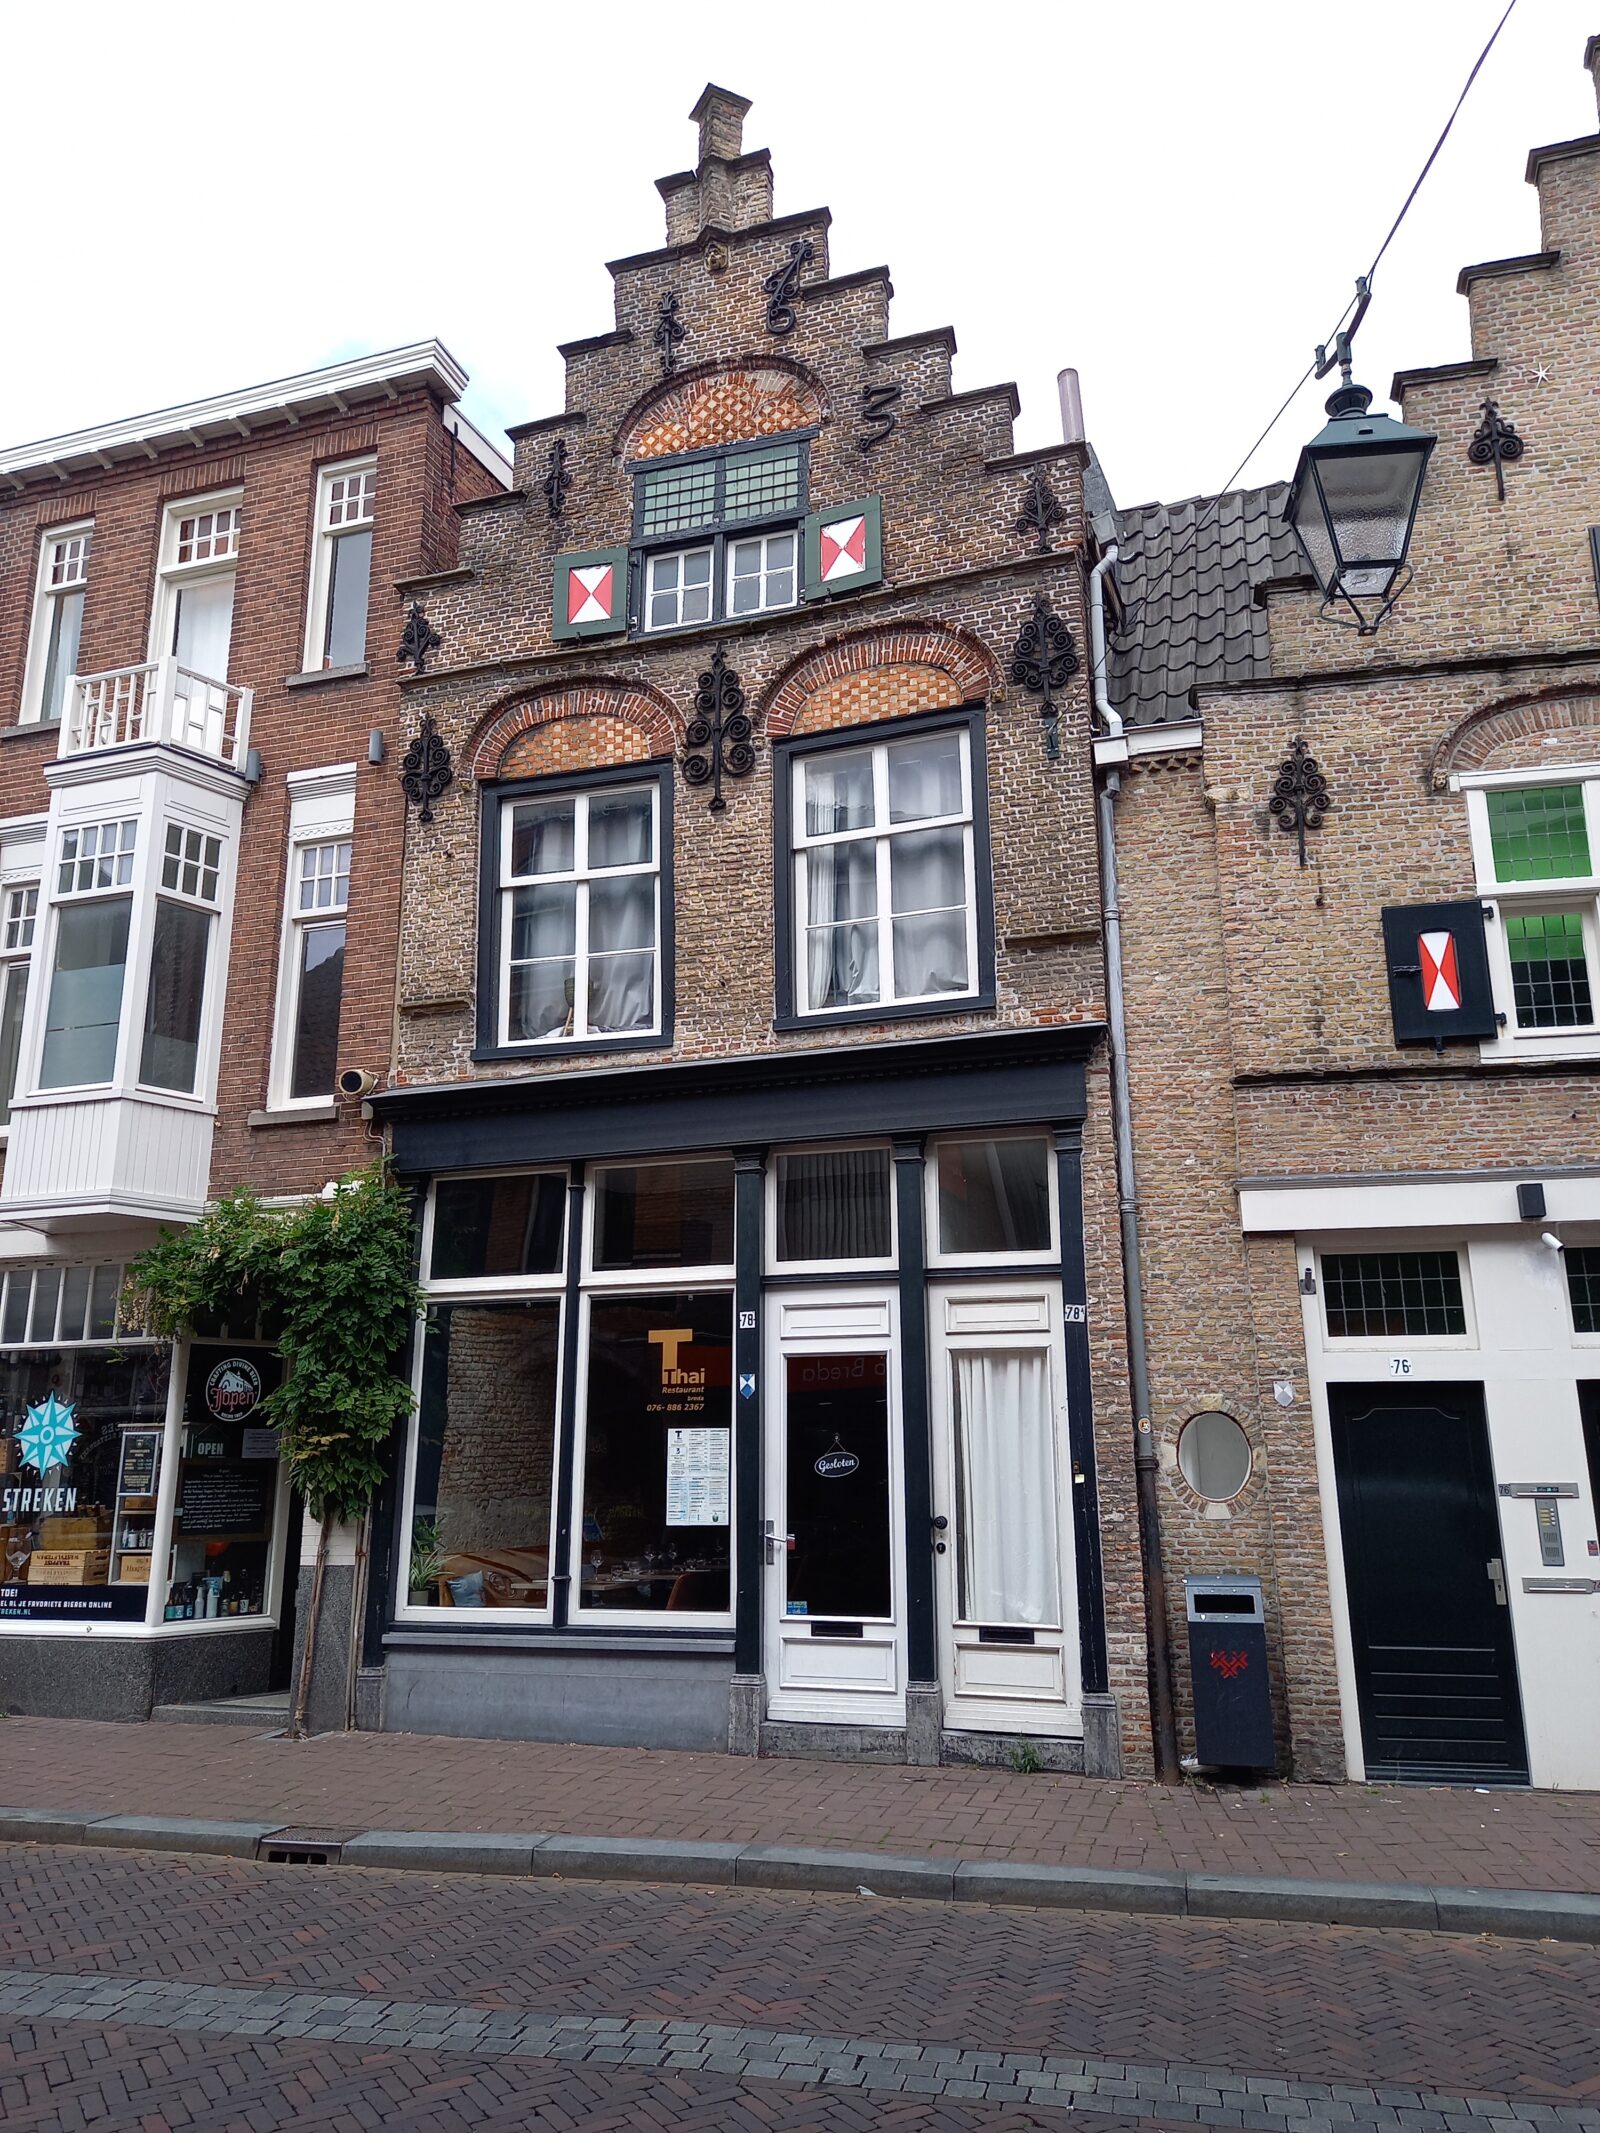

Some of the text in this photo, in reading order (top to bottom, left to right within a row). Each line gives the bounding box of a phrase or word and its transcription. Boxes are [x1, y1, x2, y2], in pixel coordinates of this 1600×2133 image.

[741, 1313, 754, 1327] 78
[232, 1361, 252, 1373] DIVINE
[249, 1370, 259, 1386] BEER
[1393, 1359, 1410, 1374] 76
[662, 1368, 705, 1385] Thai
[662, 1386, 705, 1394] Restaurant
[210, 1387, 255, 1413] Jopen
[684, 1403, 705, 1411] 2367
[197, 1442, 224, 1455] OPEN
[818, 1458, 855, 1473] Gesloten
[1500, 1486, 1510, 1494] 76
[2, 1488, 77, 1512] STREKEN
